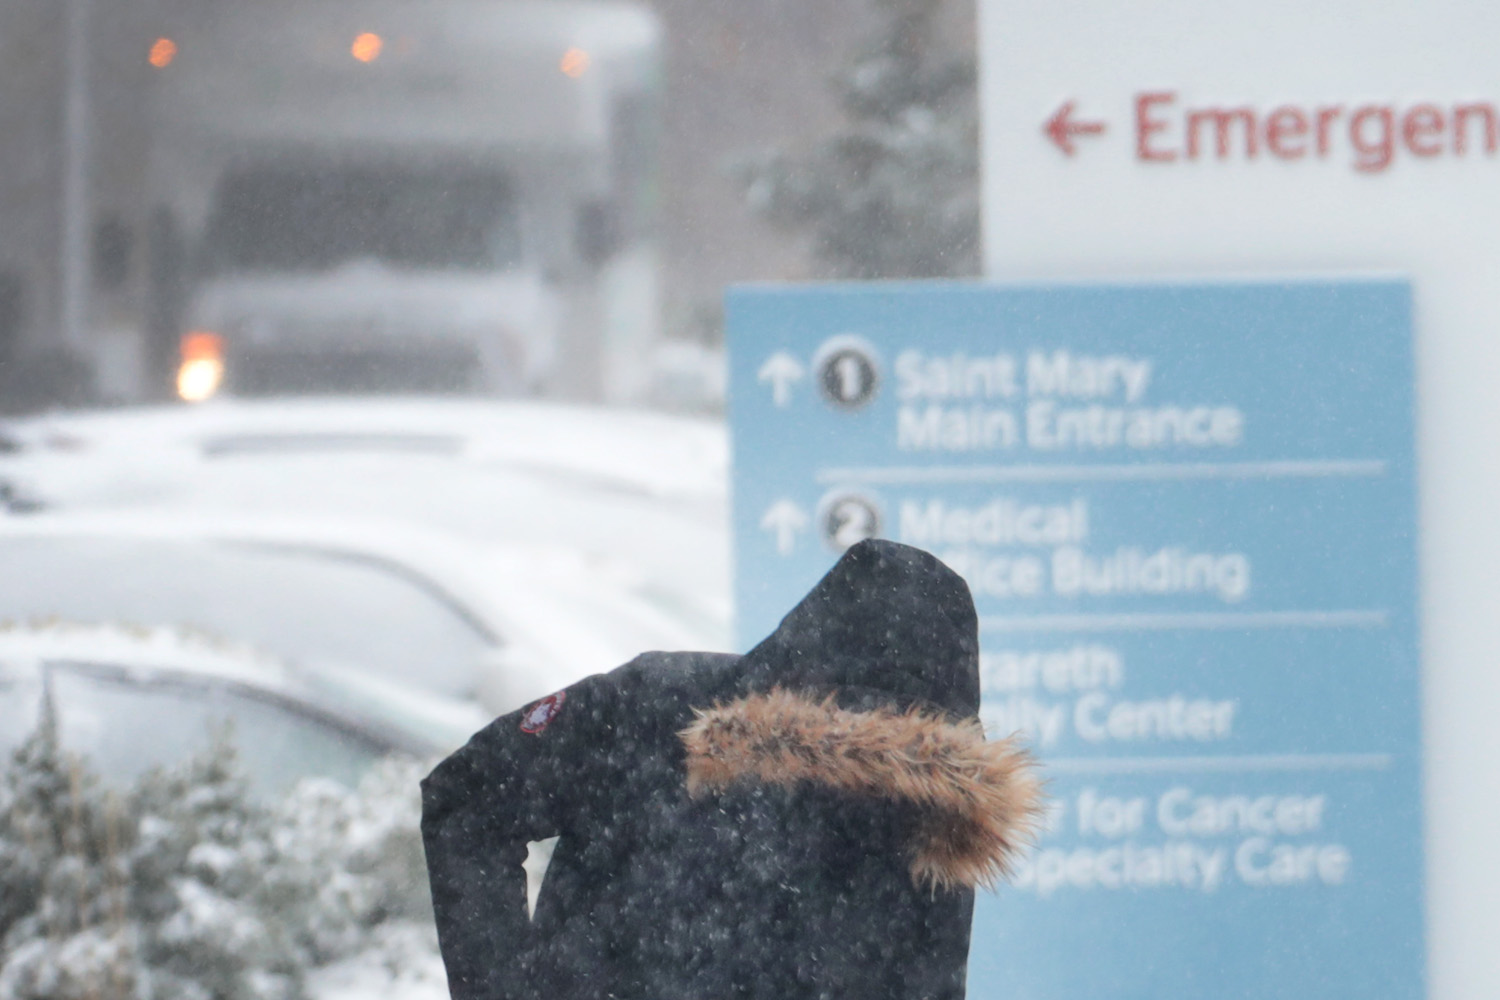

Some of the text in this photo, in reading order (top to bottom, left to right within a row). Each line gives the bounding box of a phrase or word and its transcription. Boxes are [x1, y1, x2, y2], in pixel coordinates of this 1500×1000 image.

[896, 350, 1019, 399] Saint
[1026, 349, 1150, 404] Mary
[896, 402, 1244, 451] Main Entrance
[900, 500, 1088, 545] Medical
[1051, 548, 1249, 602] Building
[1073, 693, 1236, 741] Center
[1078, 788, 1145, 836] for
[1156, 786, 1326, 835] Cancer
[1235, 836, 1350, 885] Care
